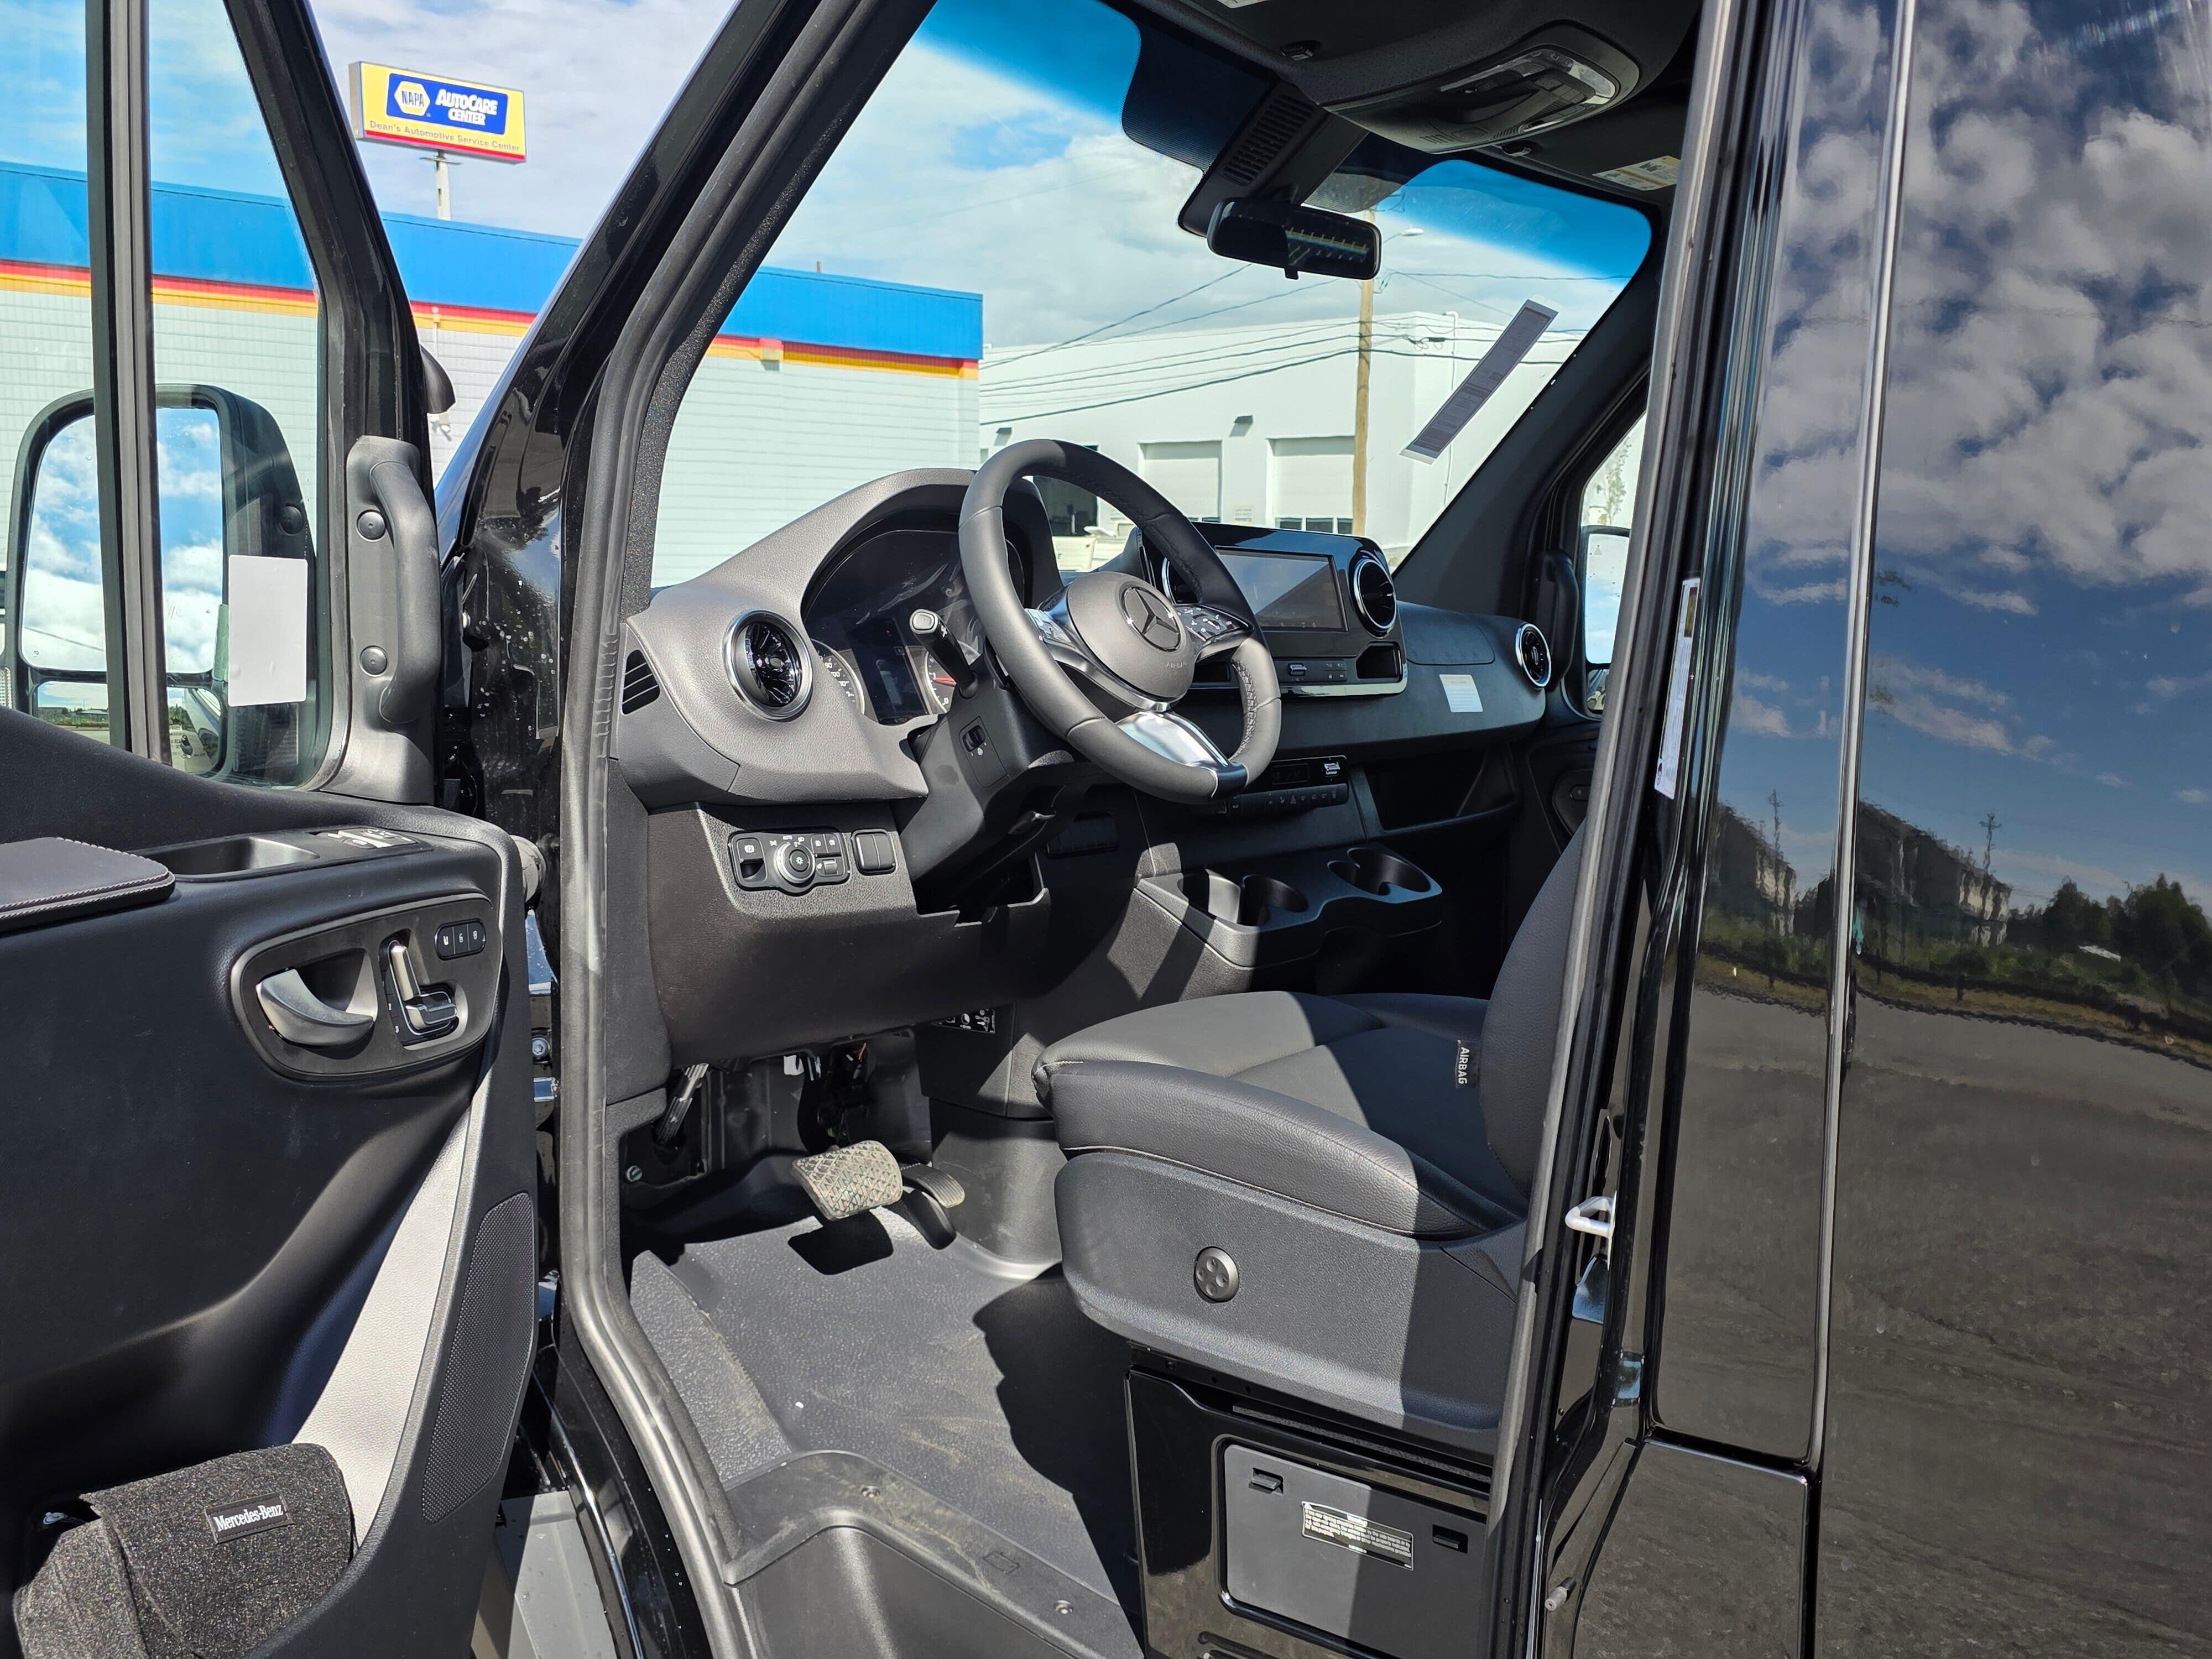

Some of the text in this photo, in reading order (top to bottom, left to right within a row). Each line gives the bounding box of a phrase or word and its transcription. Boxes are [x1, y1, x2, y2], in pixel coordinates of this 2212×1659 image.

[401, 90, 425, 108] NAPA
[448, 108, 486, 126] CENTER
[369, 120, 520, 152] Dean's Automotive Service Center
[1458, 1046, 1470, 1084] AIRBAG
[213, 1504, 283, 1532] Mercedes-Benz
